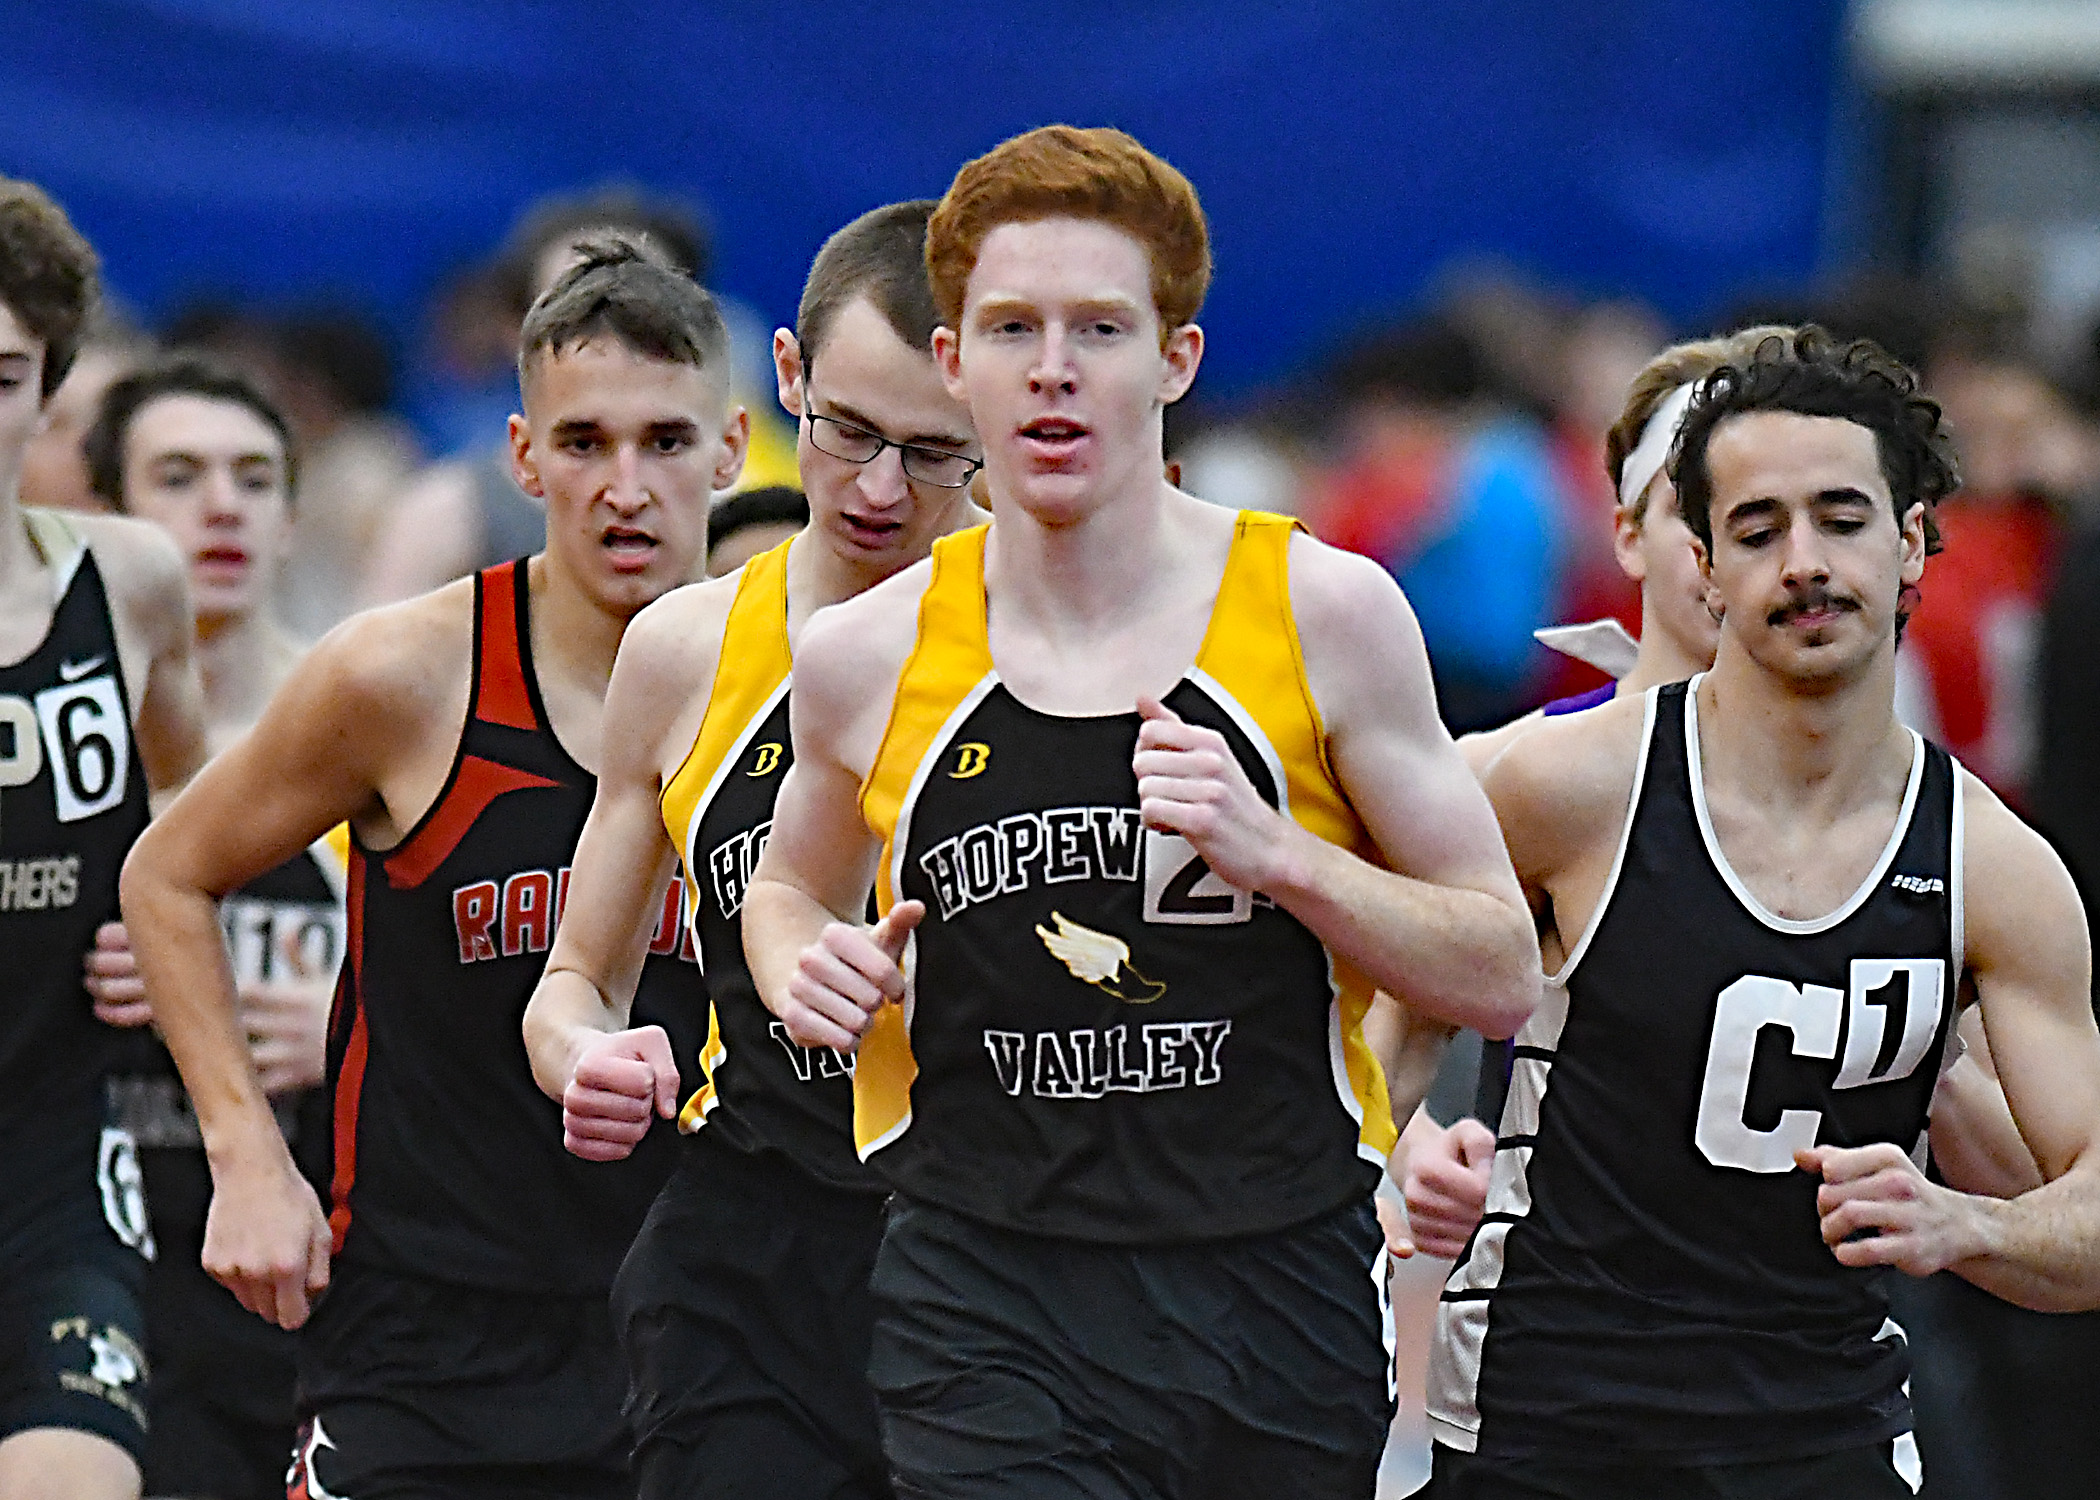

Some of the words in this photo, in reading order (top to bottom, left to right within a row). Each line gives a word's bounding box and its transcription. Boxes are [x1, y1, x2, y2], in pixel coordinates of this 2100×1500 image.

[57, 696, 115, 803] 6
[746, 743, 783, 777] B
[948, 743, 991, 779] B
[920, 807, 1275, 921] HOPEW
[984, 1020, 1232, 1099] VALLEY
[1695, 974, 1844, 1174] C
[1865, 970, 1910, 1080] 1
